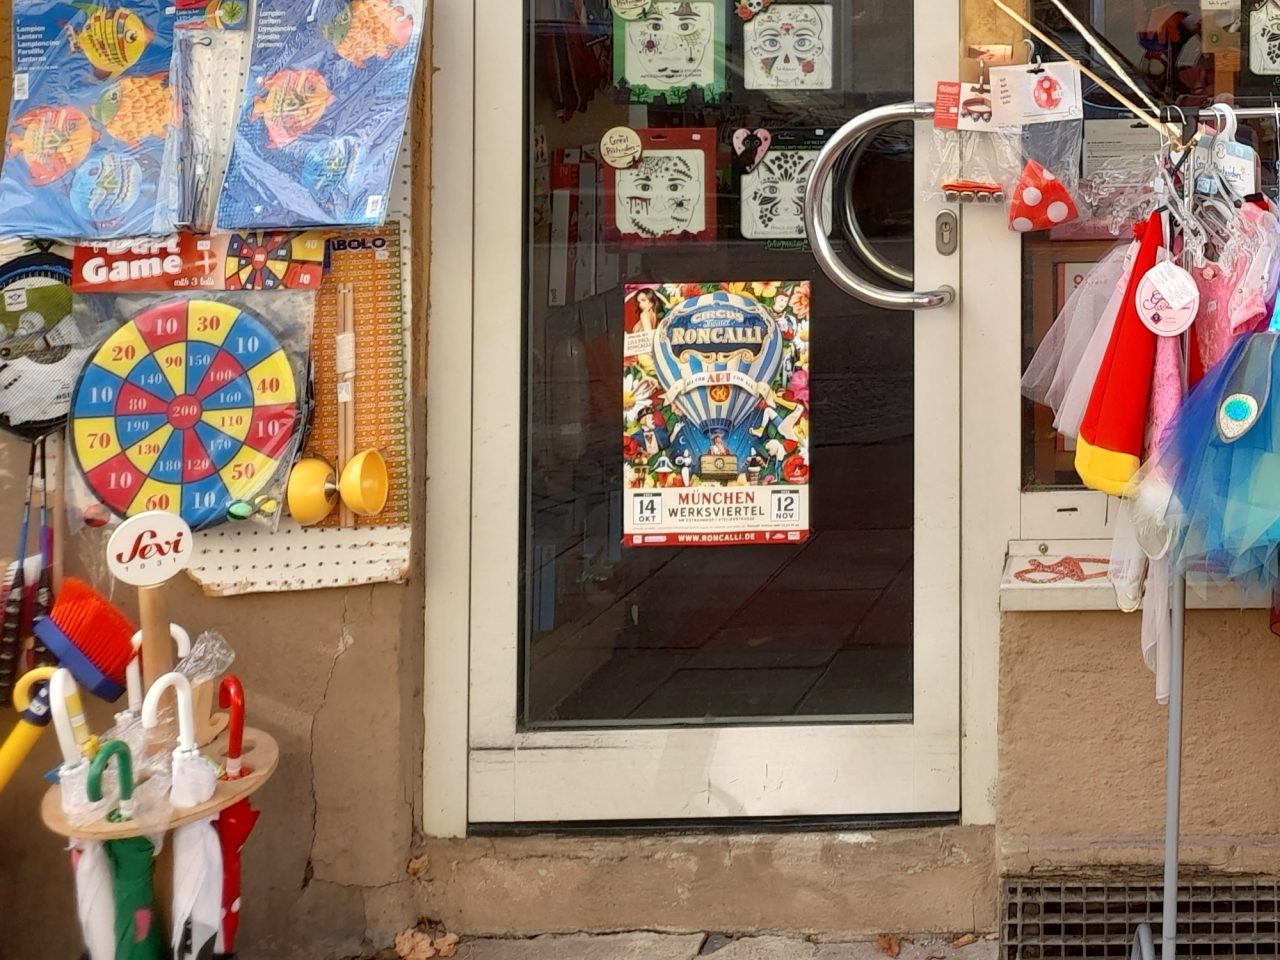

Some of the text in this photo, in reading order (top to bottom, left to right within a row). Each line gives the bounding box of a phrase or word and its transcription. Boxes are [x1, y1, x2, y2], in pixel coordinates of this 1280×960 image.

[609, 135, 629, 145] Great
[82, 254, 183, 284] Game
[191, 277, 197, 285] 3
[155, 318, 177, 335] 10
[197, 316, 220, 332] 30
[671, 326, 763, 345] RONCALLI
[236, 336, 259, 353] 10
[112, 345, 135, 361] 20
[165, 356, 182, 368] 90
[188, 355, 210, 367] 150
[140, 373, 162, 385] 140
[209, 370, 232, 382] 100
[707, 372, 731, 384] ART
[257, 377, 280, 393] 40
[88, 387, 112, 403] 10
[220, 392, 242, 403] 160
[129, 399, 146, 411] 80
[172, 405, 197, 417] 200
[126, 420, 149, 431] 190
[220, 416, 243, 427] 110
[256, 421, 279, 437] 10
[87, 433, 111, 448] 70
[137, 443, 160, 455] 130
[158, 460, 181, 471] 180
[187, 459, 210, 470] 120
[232, 463, 255, 480] 50
[108, 472, 132, 489] 10
[145, 494, 170, 510] 60
[192, 492, 216, 508] 10
[639, 490, 794, 515] 14 MÜNCHEN 12
[668, 505, 765, 518] WERKSVIERTEL
[678, 532, 756, 542] WWW.RONCALLI.DE
[116, 530, 183, 565] Sevi
[124, 557, 178, 573] 1831
